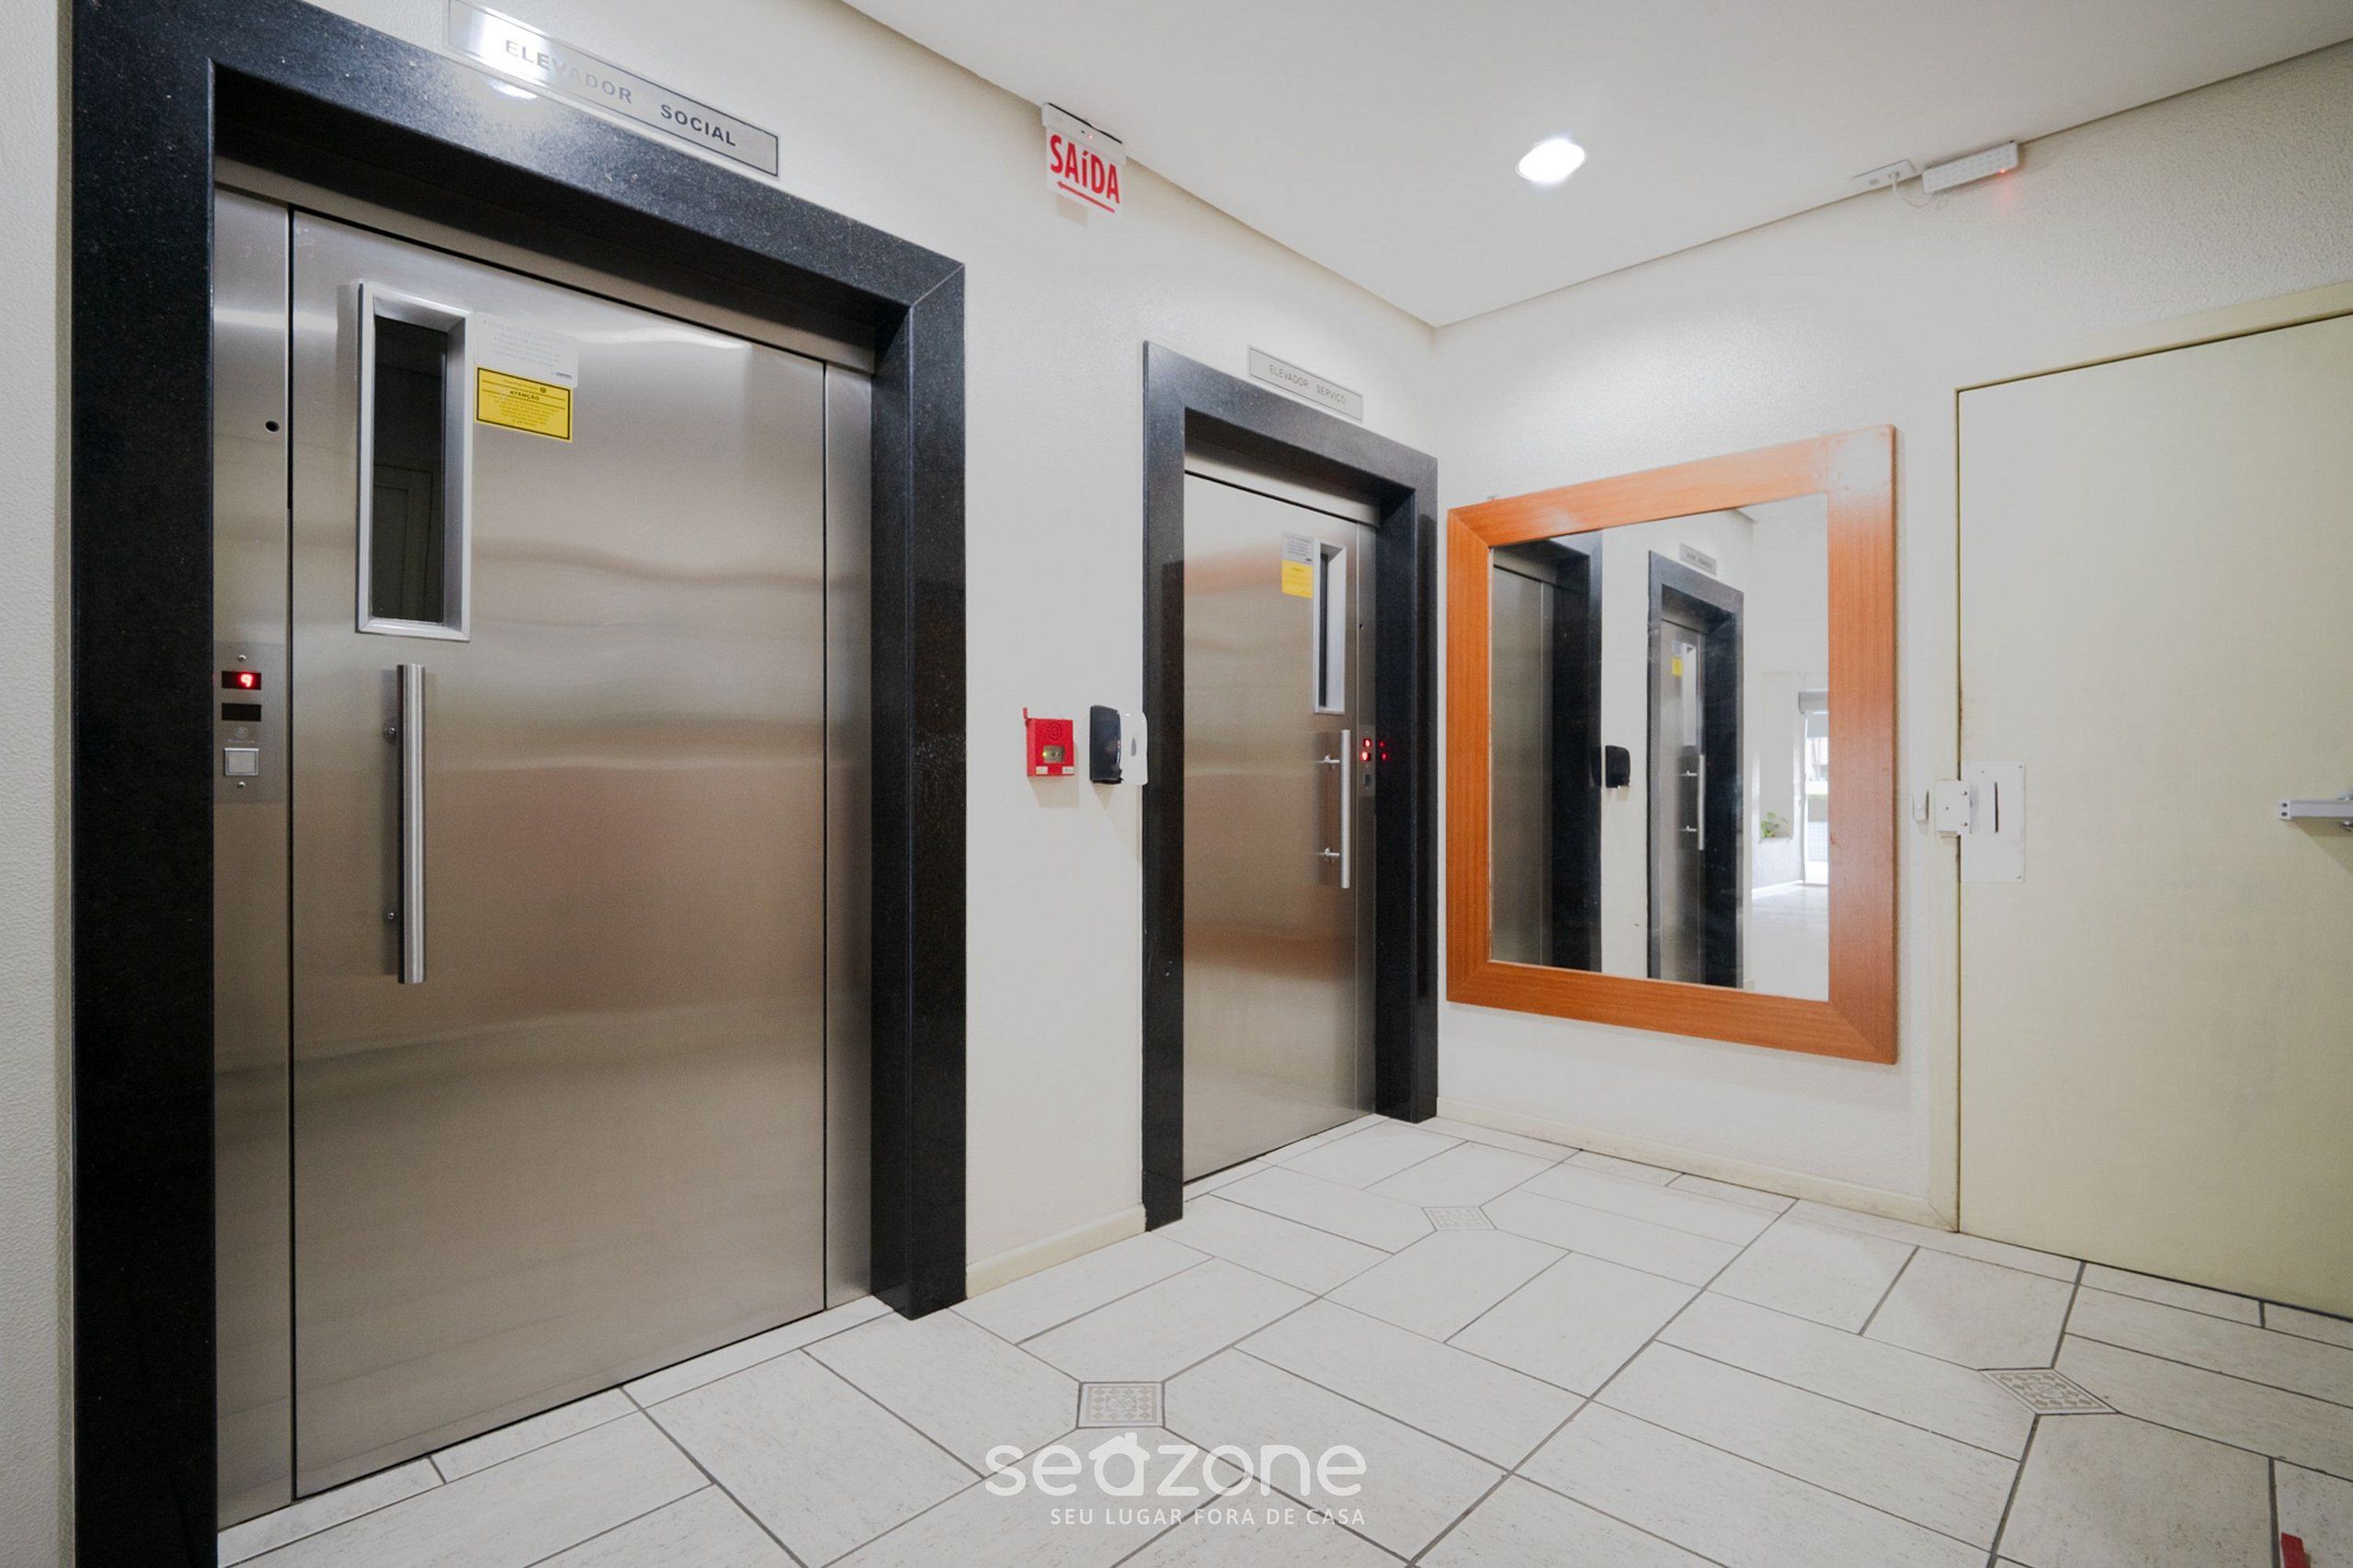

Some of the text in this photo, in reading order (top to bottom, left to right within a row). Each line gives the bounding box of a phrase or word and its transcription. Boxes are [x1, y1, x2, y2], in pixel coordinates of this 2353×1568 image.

[505, 39, 737, 147] ELEVADOR SOCIAL
[1268, 364, 1310, 389] ELEVADOR
[509, 390, 540, 402] ATENÇÃO
[240, 673, 254, 688] 9
